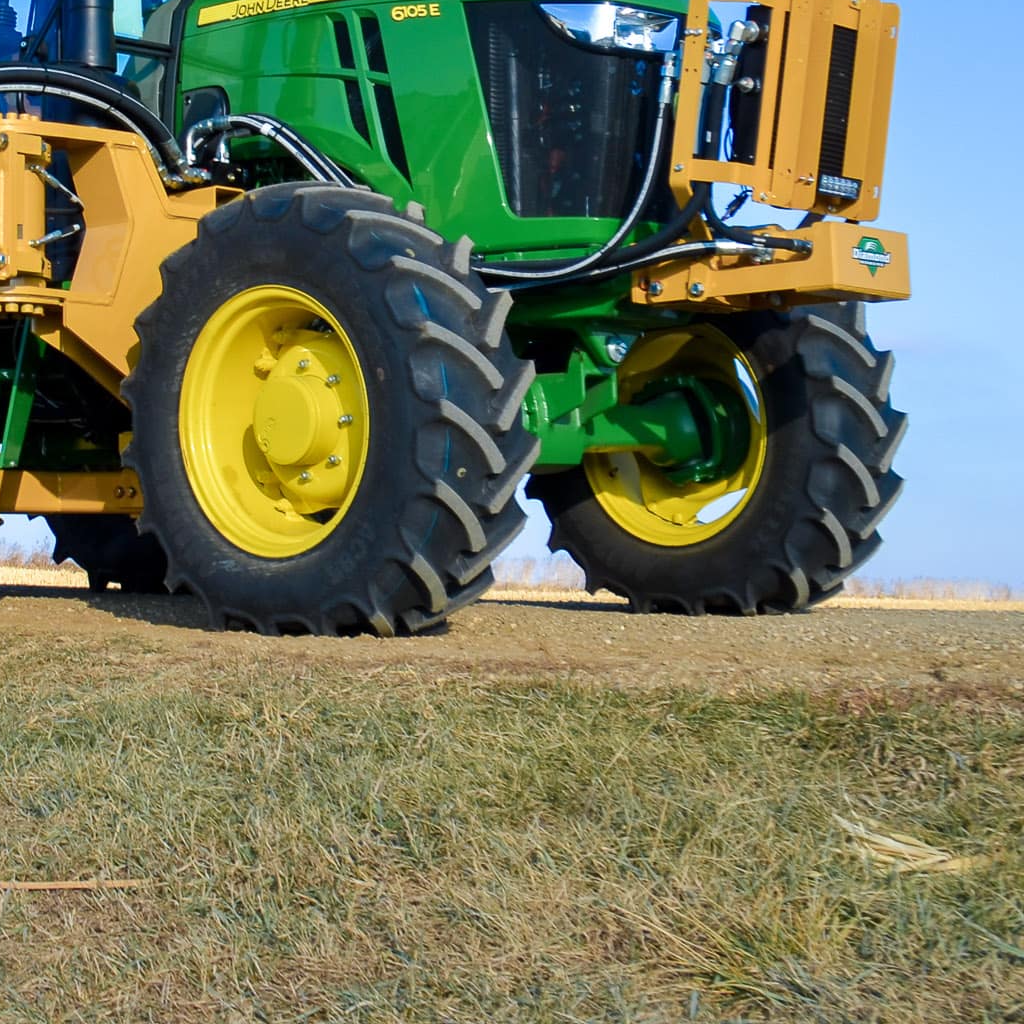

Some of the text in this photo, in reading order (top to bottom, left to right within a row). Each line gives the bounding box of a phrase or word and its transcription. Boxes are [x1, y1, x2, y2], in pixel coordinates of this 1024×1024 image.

[232, 2, 264, 17] JOHN
[391, 3, 441, 21] 6105 E
